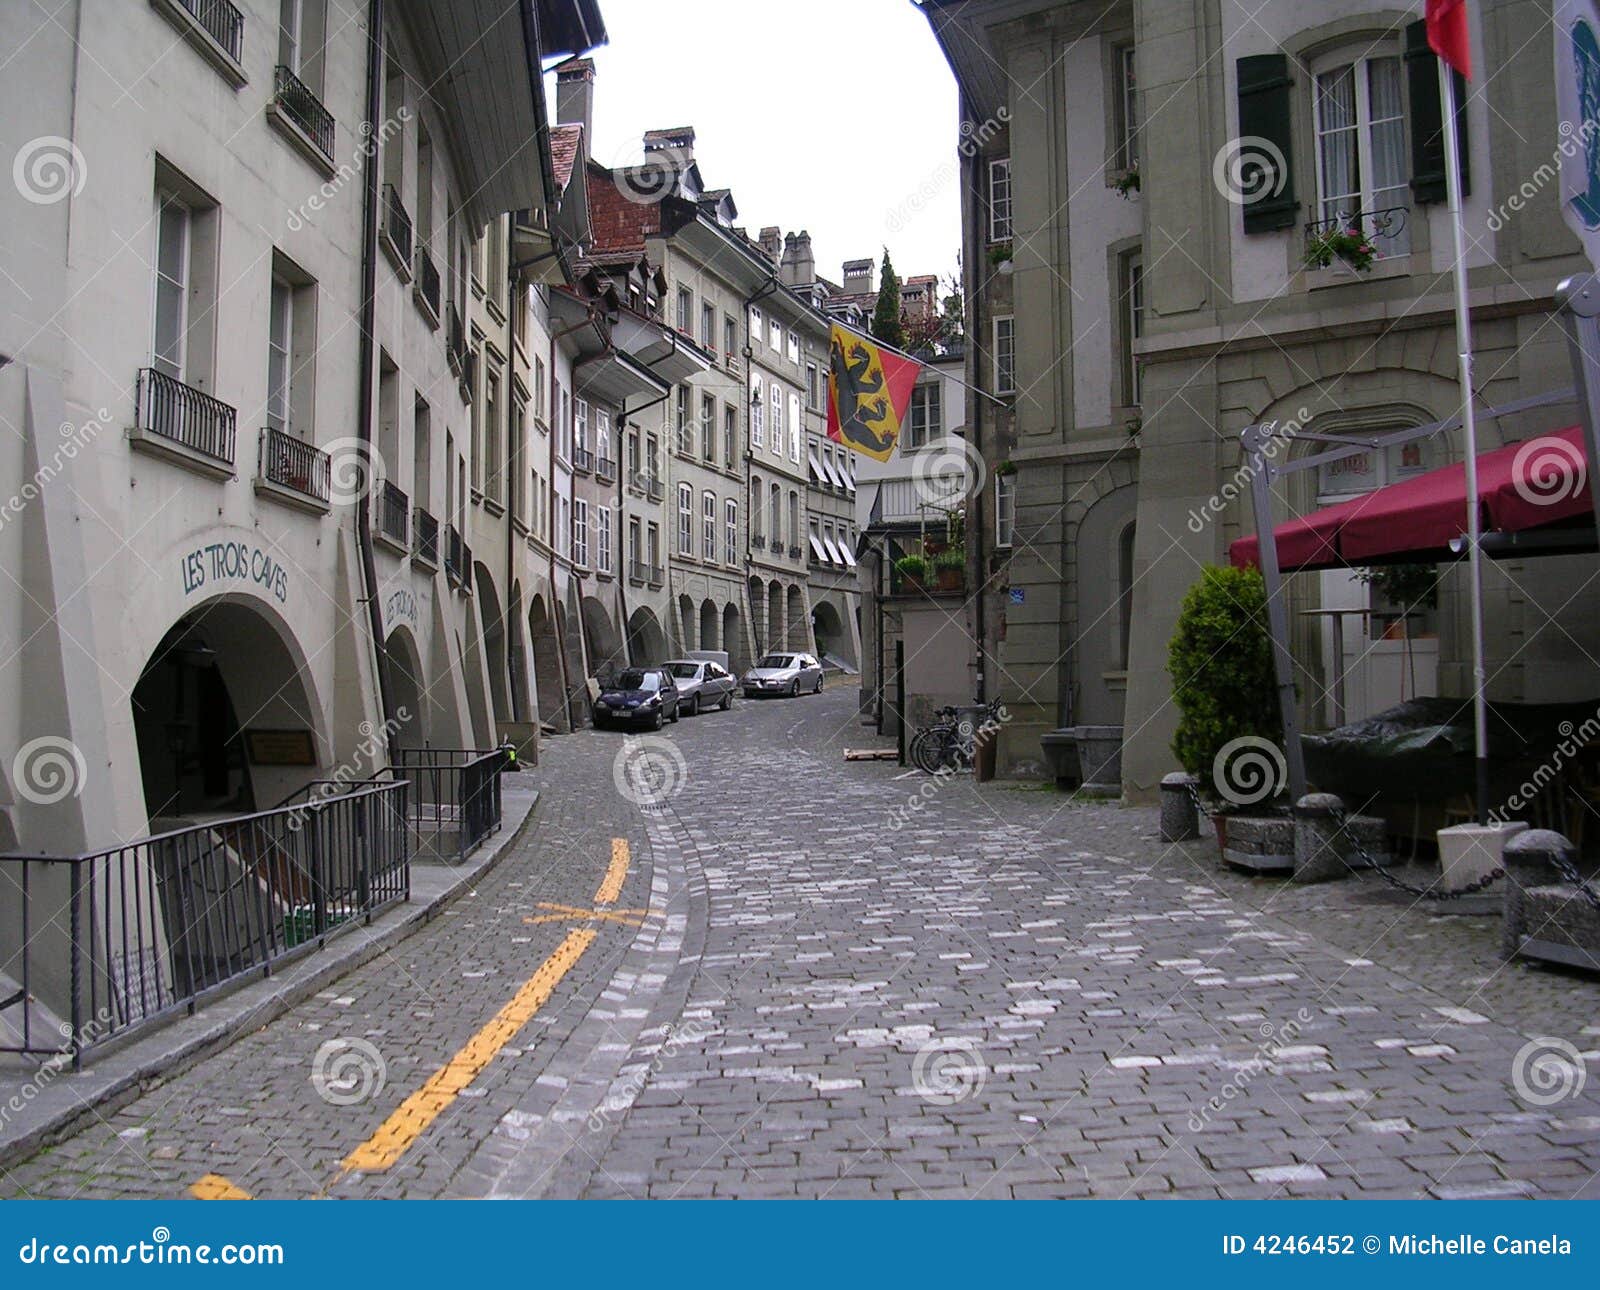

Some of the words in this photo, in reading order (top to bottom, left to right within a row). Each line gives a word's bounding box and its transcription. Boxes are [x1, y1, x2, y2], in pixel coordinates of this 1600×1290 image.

[182, 550, 205, 595] LES
[205, 542, 248, 579] TROIS
[251, 549, 288, 603] CAVES
